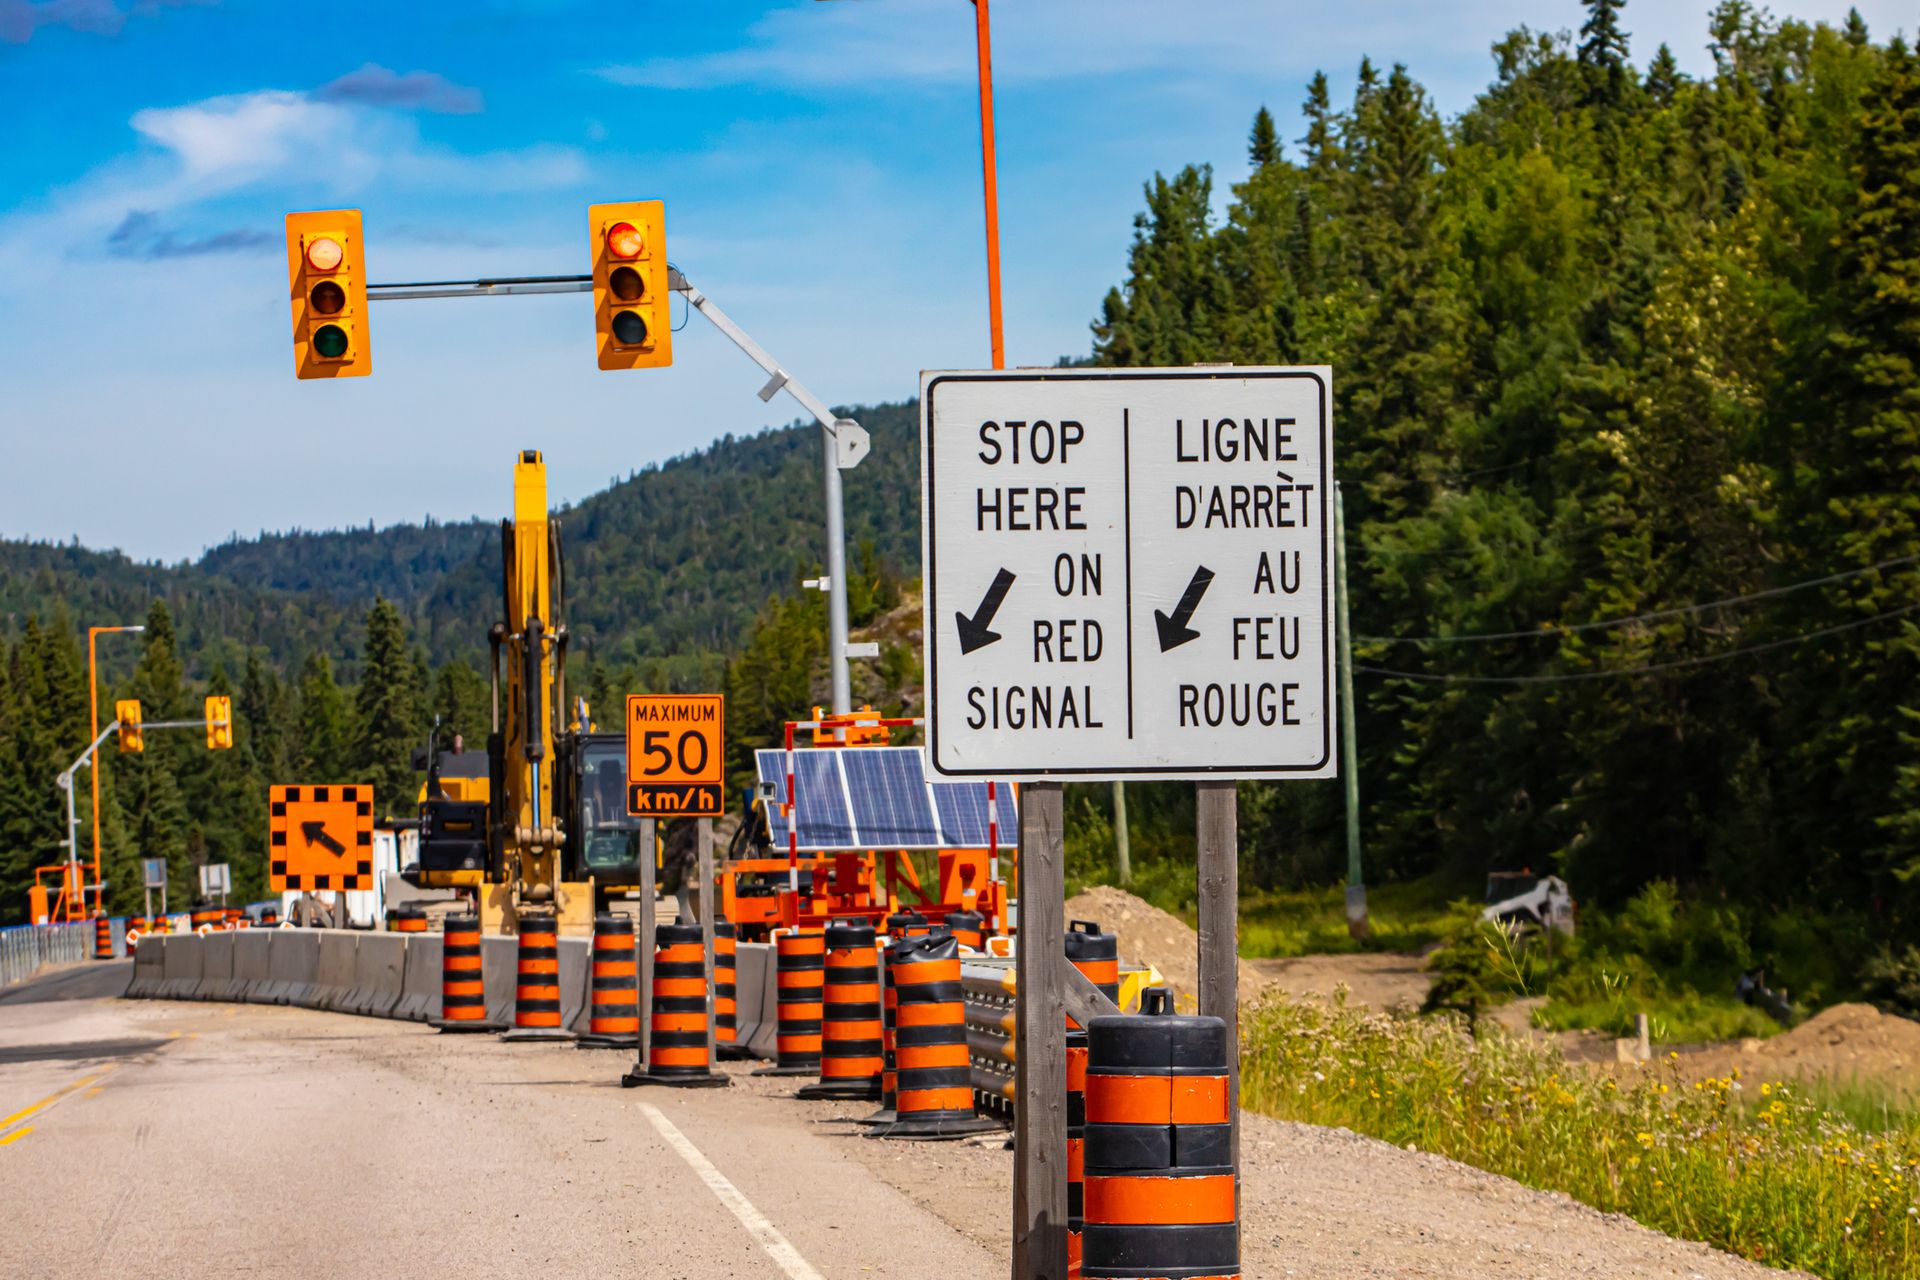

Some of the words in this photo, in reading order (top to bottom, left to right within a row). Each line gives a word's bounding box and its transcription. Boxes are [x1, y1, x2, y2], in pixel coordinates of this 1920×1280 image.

[979, 420, 1084, 464] STOP
[1177, 419, 1297, 462] LIGNE
[978, 487, 1086, 530] HERE
[1055, 553, 1101, 596] ON
[1254, 551, 1299, 594] AU
[1034, 620, 1102, 662] RED
[1233, 617, 1299, 660] FEU
[637, 706, 714, 721] MAXIMUM
[967, 686, 1102, 729] SIGNAL
[1180, 683, 1300, 727] ROUGE
[644, 731, 707, 775] 50
[637, 788, 713, 809] km/h
